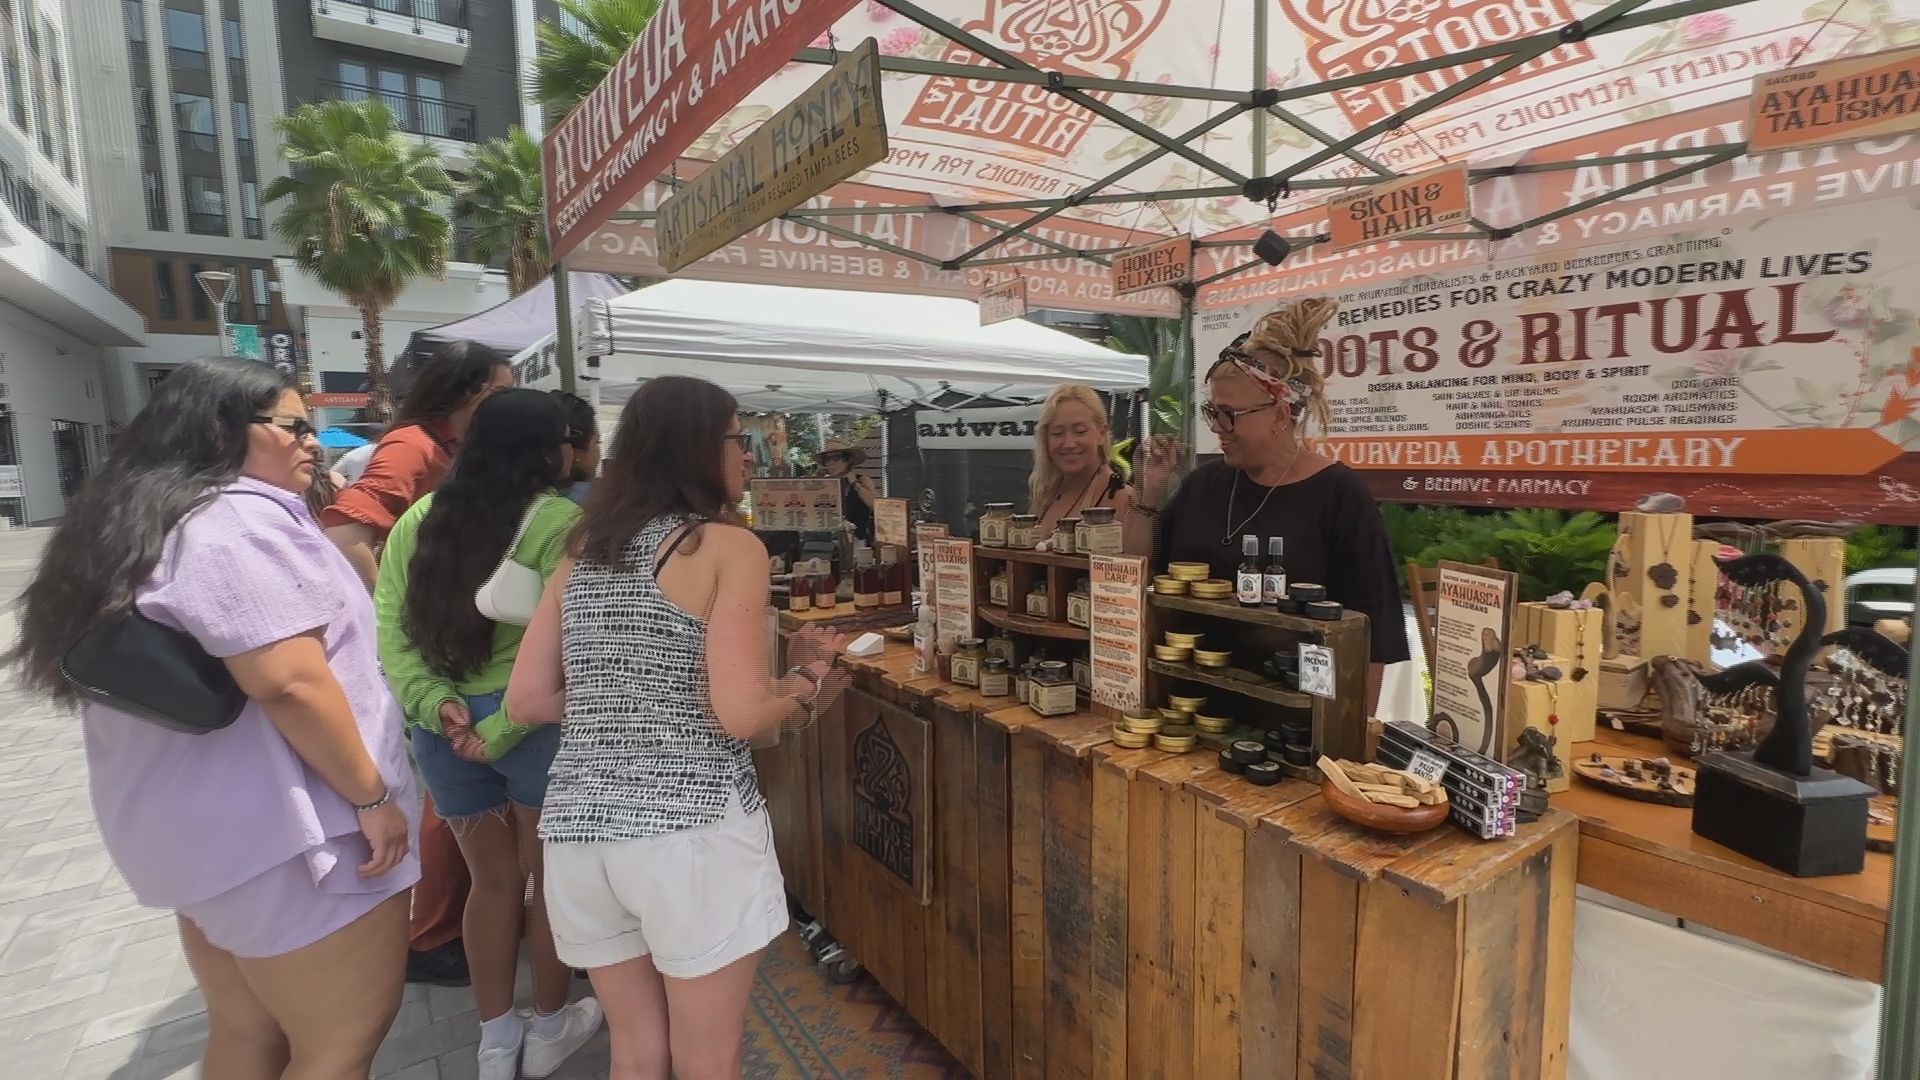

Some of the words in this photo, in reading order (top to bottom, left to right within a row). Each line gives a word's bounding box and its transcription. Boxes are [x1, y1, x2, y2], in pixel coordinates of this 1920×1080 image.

[553, 0, 687, 202] AYURVEDA
[1760, 66, 1920, 114] AYAHUA
[1765, 90, 1920, 134] TALISM
[556, 178, 602, 237] BEEHIVE
[603, 82, 684, 191] FARMACY
[688, 68, 704, 107] &
[658, 143, 764, 250] ARTISANAL
[771, 58, 868, 179] HONEY
[768, 173, 802, 204] RESCUED
[804, 155, 833, 183] TAMPA
[835, 140, 860, 164] BEES
[1350, 189, 1419, 222] SKIN
[1424, 182, 1443, 202] &
[1361, 206, 1434, 241] HAIR
[1438, 210, 1462, 224] CARE
[1123, 245, 1177, 273] HONEY
[1117, 262, 1186, 292] ELIXIRS
[1338, 294, 1441, 327] REMEDIES
[1450, 286, 1498, 307] FOR
[1507, 273, 1594, 301] CRAZY
[1606, 258, 1746, 290] MODERN
[1759, 250, 1873, 279] LIVES
[1412, 275, 1475, 295] HERBALISTS
[1480, 272, 1491, 282] &
[1495, 261, 1559, 280] BACKYARD
[1318, 326, 1440, 381] OOTS
[1458, 319, 1502, 370] &
[1516, 282, 1839, 366] RITUAL
[1368, 382, 1403, 393] DOSHA
[1406, 378, 1468, 391] BALANCING
[1473, 375, 1496, 387] FOR
[1543, 369, 1580, 382] BODY
[1586, 368, 1597, 379] &
[1600, 365, 1651, 380] SPIRIT
[1561, 417, 1622, 427] AYURVEDIC
[1626, 416, 1665, 426] PULSE
[1670, 414, 1737, 425] READINGS
[1315, 440, 1462, 467] AYURVEDA
[1480, 437, 1745, 467] APOTHECARY
[1402, 477, 1419, 491] &
[1425, 477, 1492, 493] BEEHIVE
[1497, 478, 1593, 496] FARMACY
[1104, 571, 1127, 584] CARE
[1440, 581, 1501, 609] AYAHUASCA
[1451, 599, 1488, 614] TALISMANS
[1303, 656, 1329, 668] INCENSE
